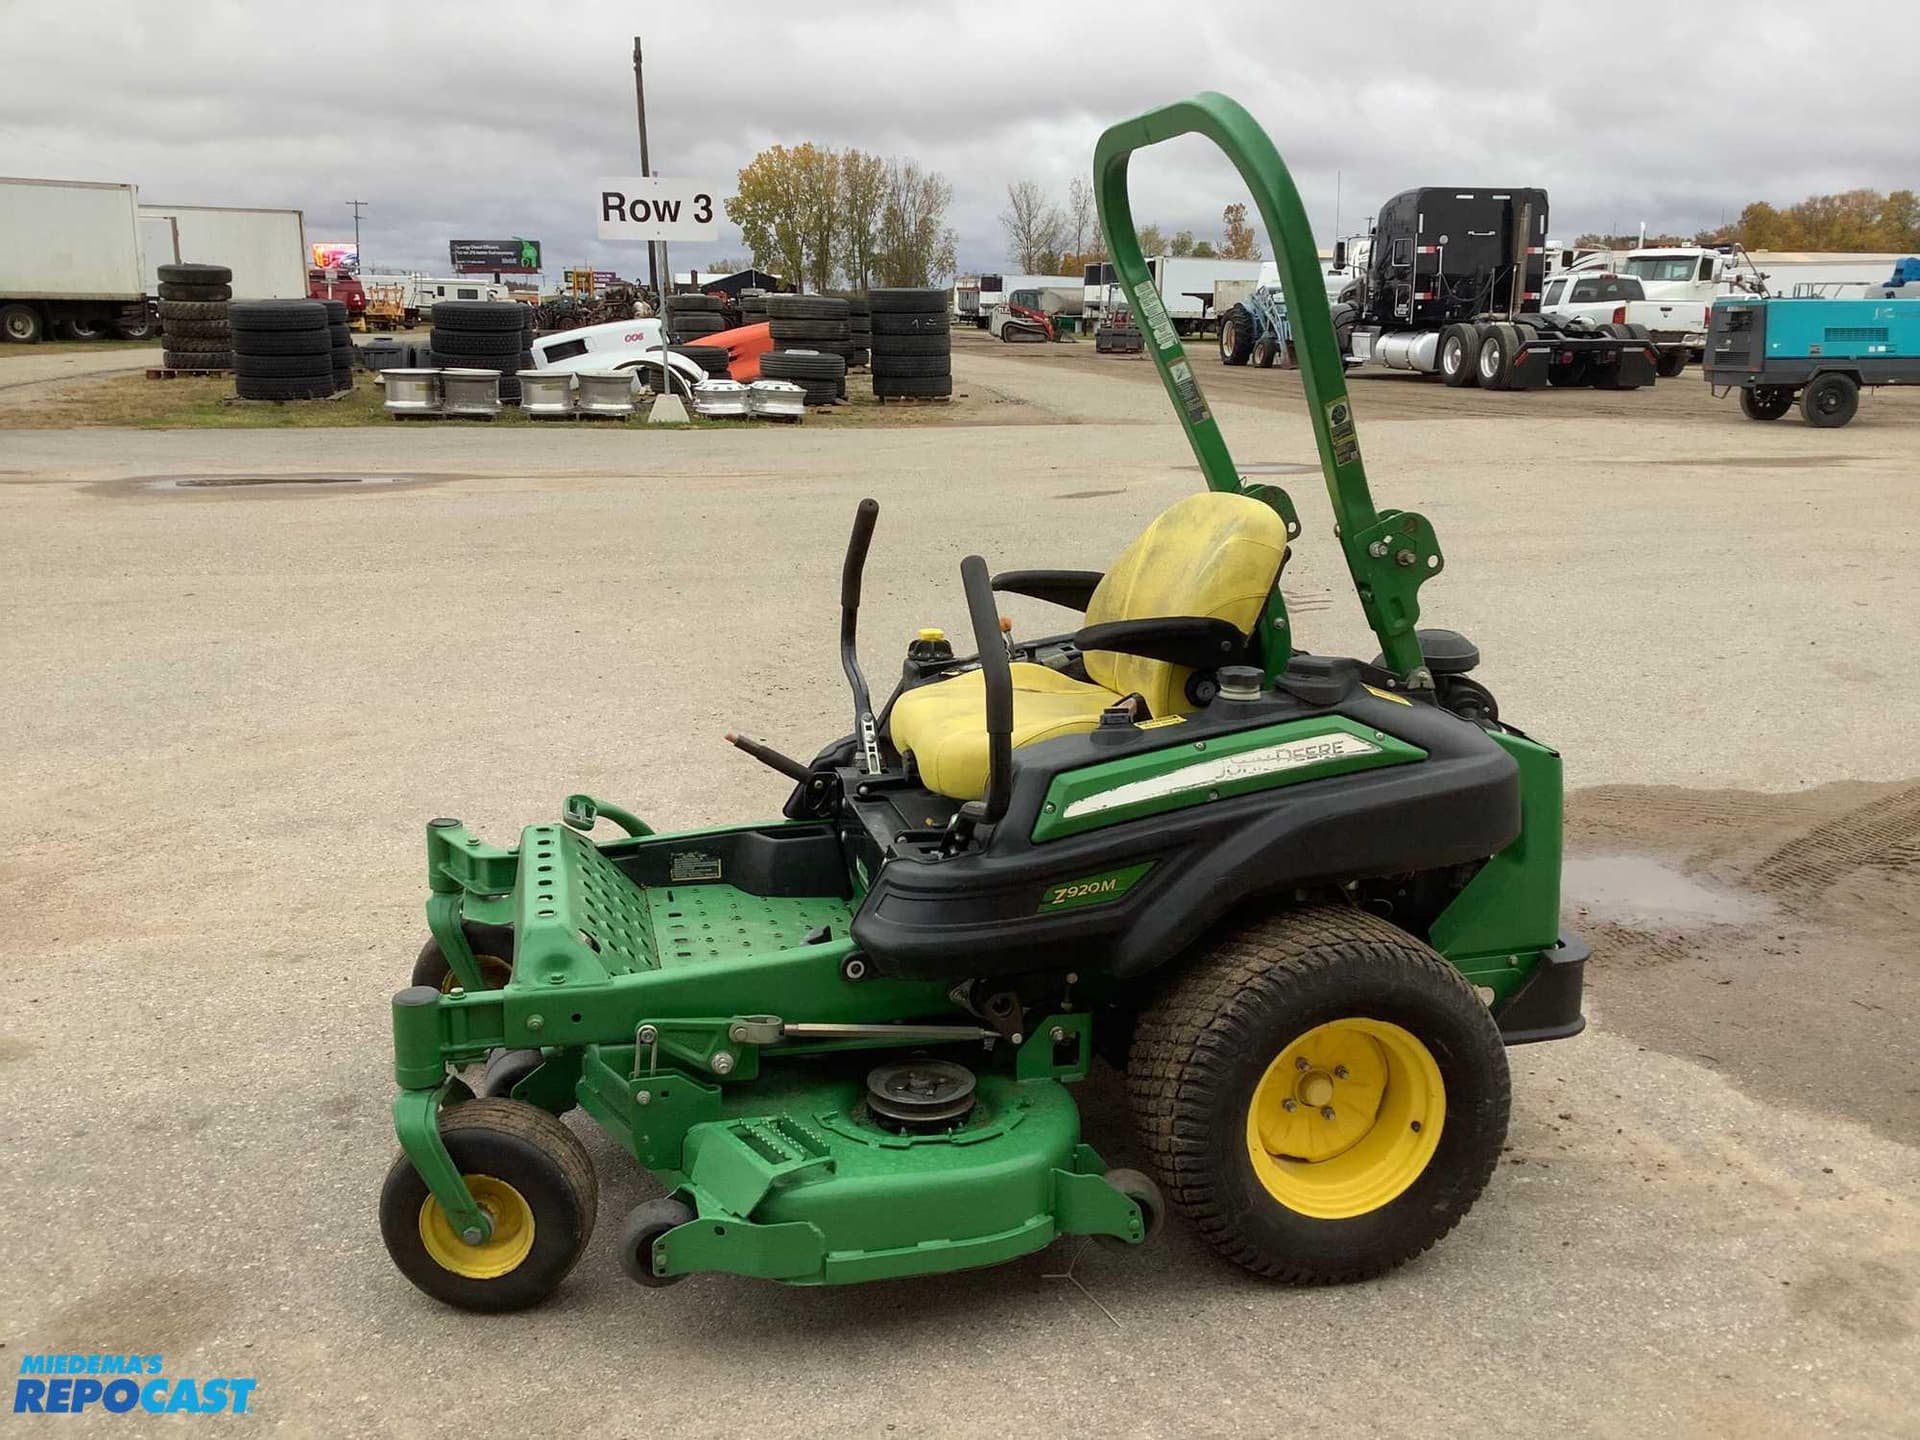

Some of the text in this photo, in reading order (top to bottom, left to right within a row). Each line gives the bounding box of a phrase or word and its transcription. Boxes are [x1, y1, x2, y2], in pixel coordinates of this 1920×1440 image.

[602, 191, 713, 224] Row 3
[1276, 740, 1345, 763] DEERE
[1052, 879, 1117, 904] Z920M
